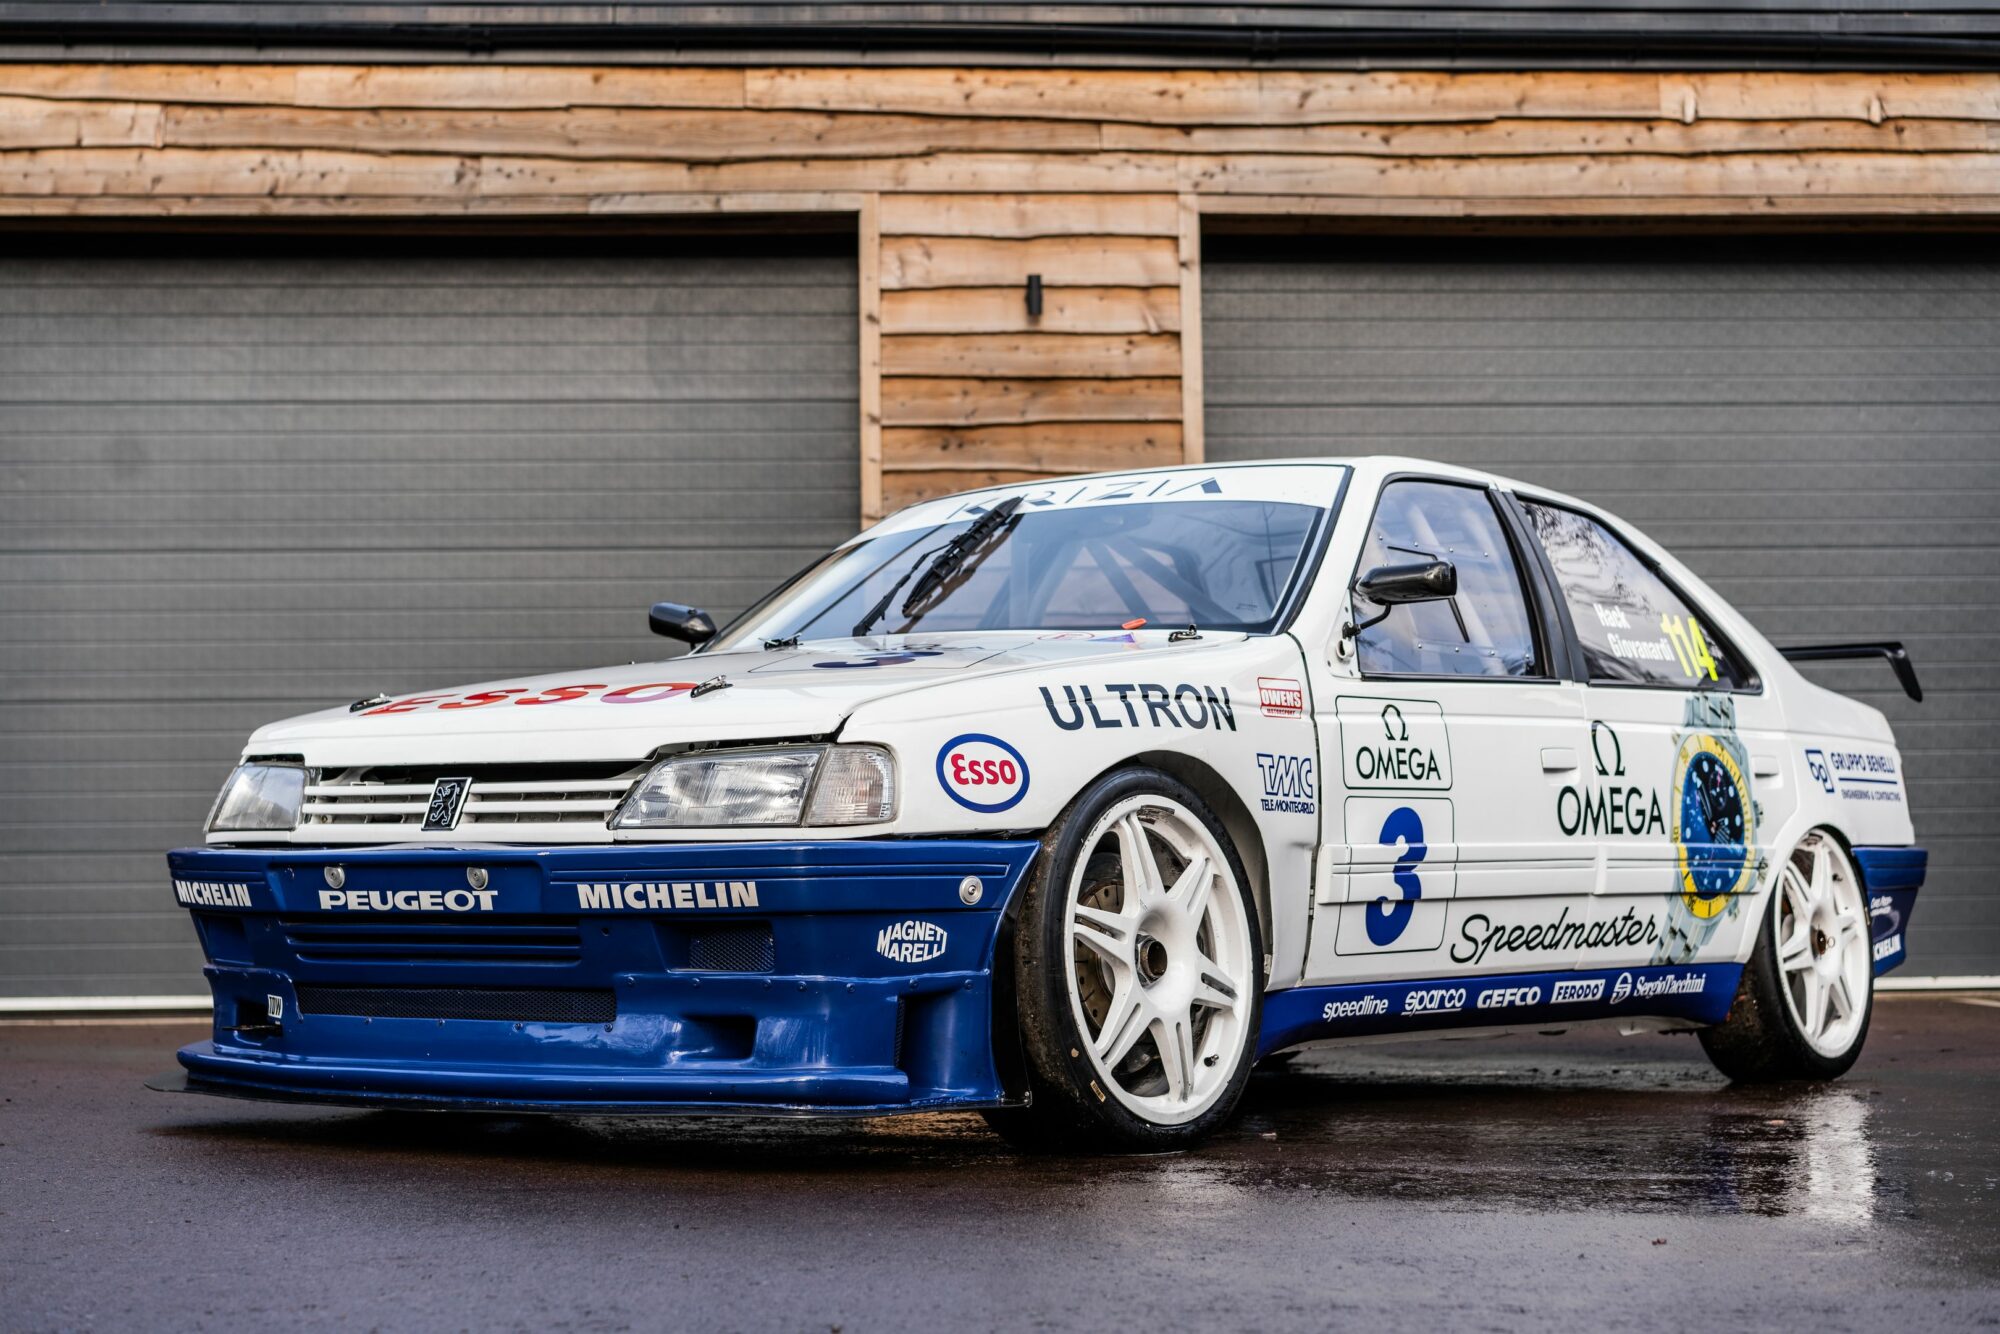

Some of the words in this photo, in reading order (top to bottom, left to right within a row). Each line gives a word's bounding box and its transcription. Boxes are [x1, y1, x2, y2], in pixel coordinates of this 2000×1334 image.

[1593, 602, 1631, 629] Hack
[1607, 633, 1676, 661] Giovanardi
[1660, 613, 1719, 681] 114
[358, 682, 699, 717] ESSO
[1038, 683, 1236, 731] ULTRON
[1261, 689, 1301, 708] OWENS
[1256, 752, 1314, 799] TMC
[1356, 746, 1441, 780] OMEGA
[1830, 752, 1867, 772] GRUPPO
[1557, 785, 1666, 836] OMEGA
[1366, 806, 1428, 947] 3
[175, 879, 252, 907] MICHELIN
[318, 889, 499, 912] PEUGEOT
[577, 881, 760, 910] MICHELIN
[877, 920, 948, 955] MAGNETI
[1450, 906, 1659, 966] Speedmaster
[1404, 988, 1466, 1017] sparco
[1477, 986, 1541, 1008] GEFCO
[1556, 981, 1604, 1001] FERODO
[269, 996, 282, 1016] TOW
[1323, 995, 1389, 1022] speedline
